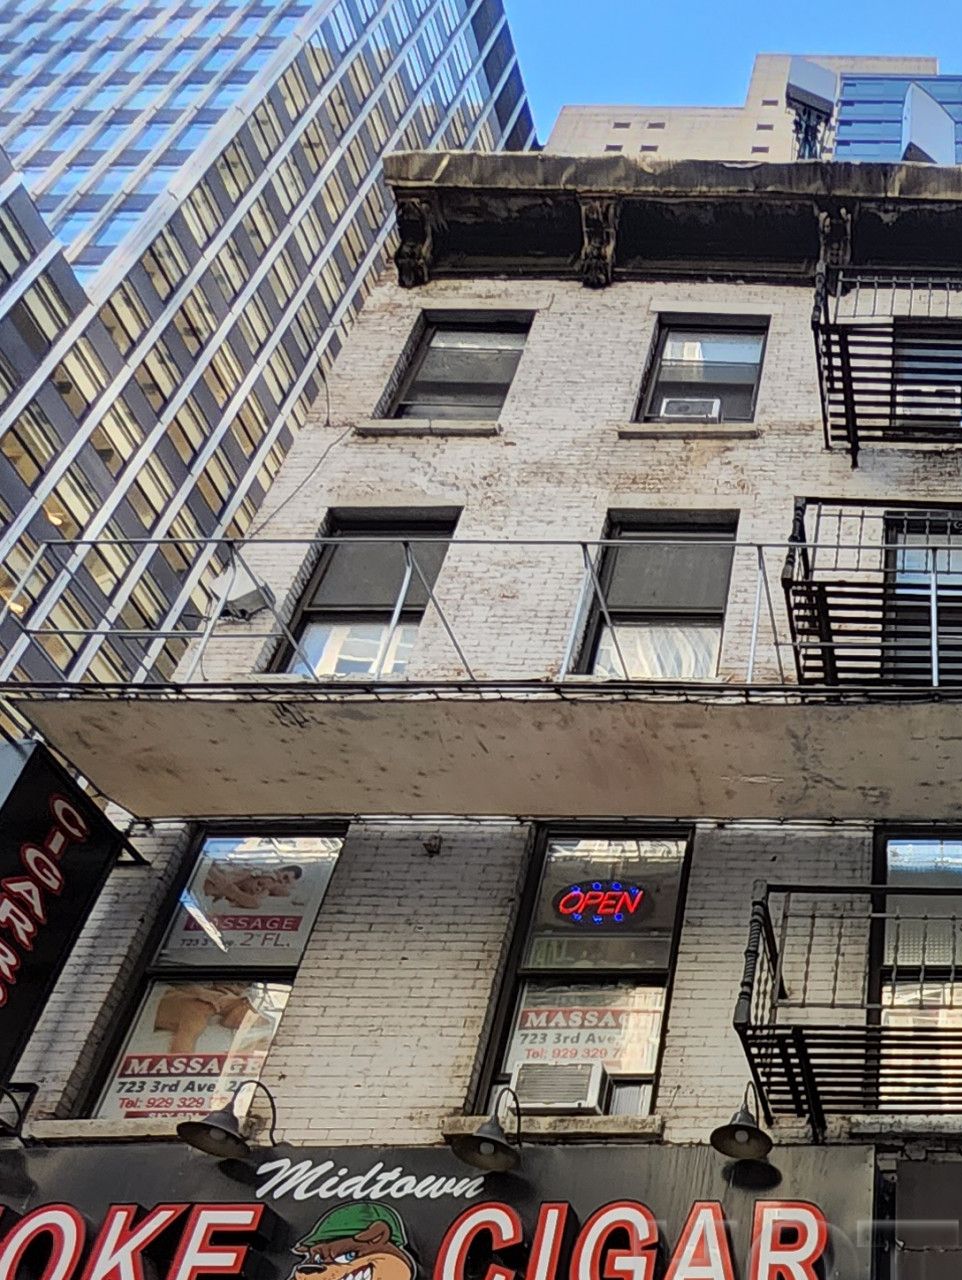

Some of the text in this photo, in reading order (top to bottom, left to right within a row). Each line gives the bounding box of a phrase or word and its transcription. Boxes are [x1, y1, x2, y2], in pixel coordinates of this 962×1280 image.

[559, 890, 643, 914] OPEN
[524, 1011, 650, 1028] MASSA
[520, 1034, 547, 1045] 723
[552, 1033, 581, 1044] 3rd
[125, 1056, 262, 1075] MASSAGE
[116, 1081, 146, 1093] 723
[149, 1080, 180, 1093] 3rd
[145, 1097, 174, 1109] 929
[177, 1097, 204, 1109] 329
[256, 1158, 485, 1200] Midtown
